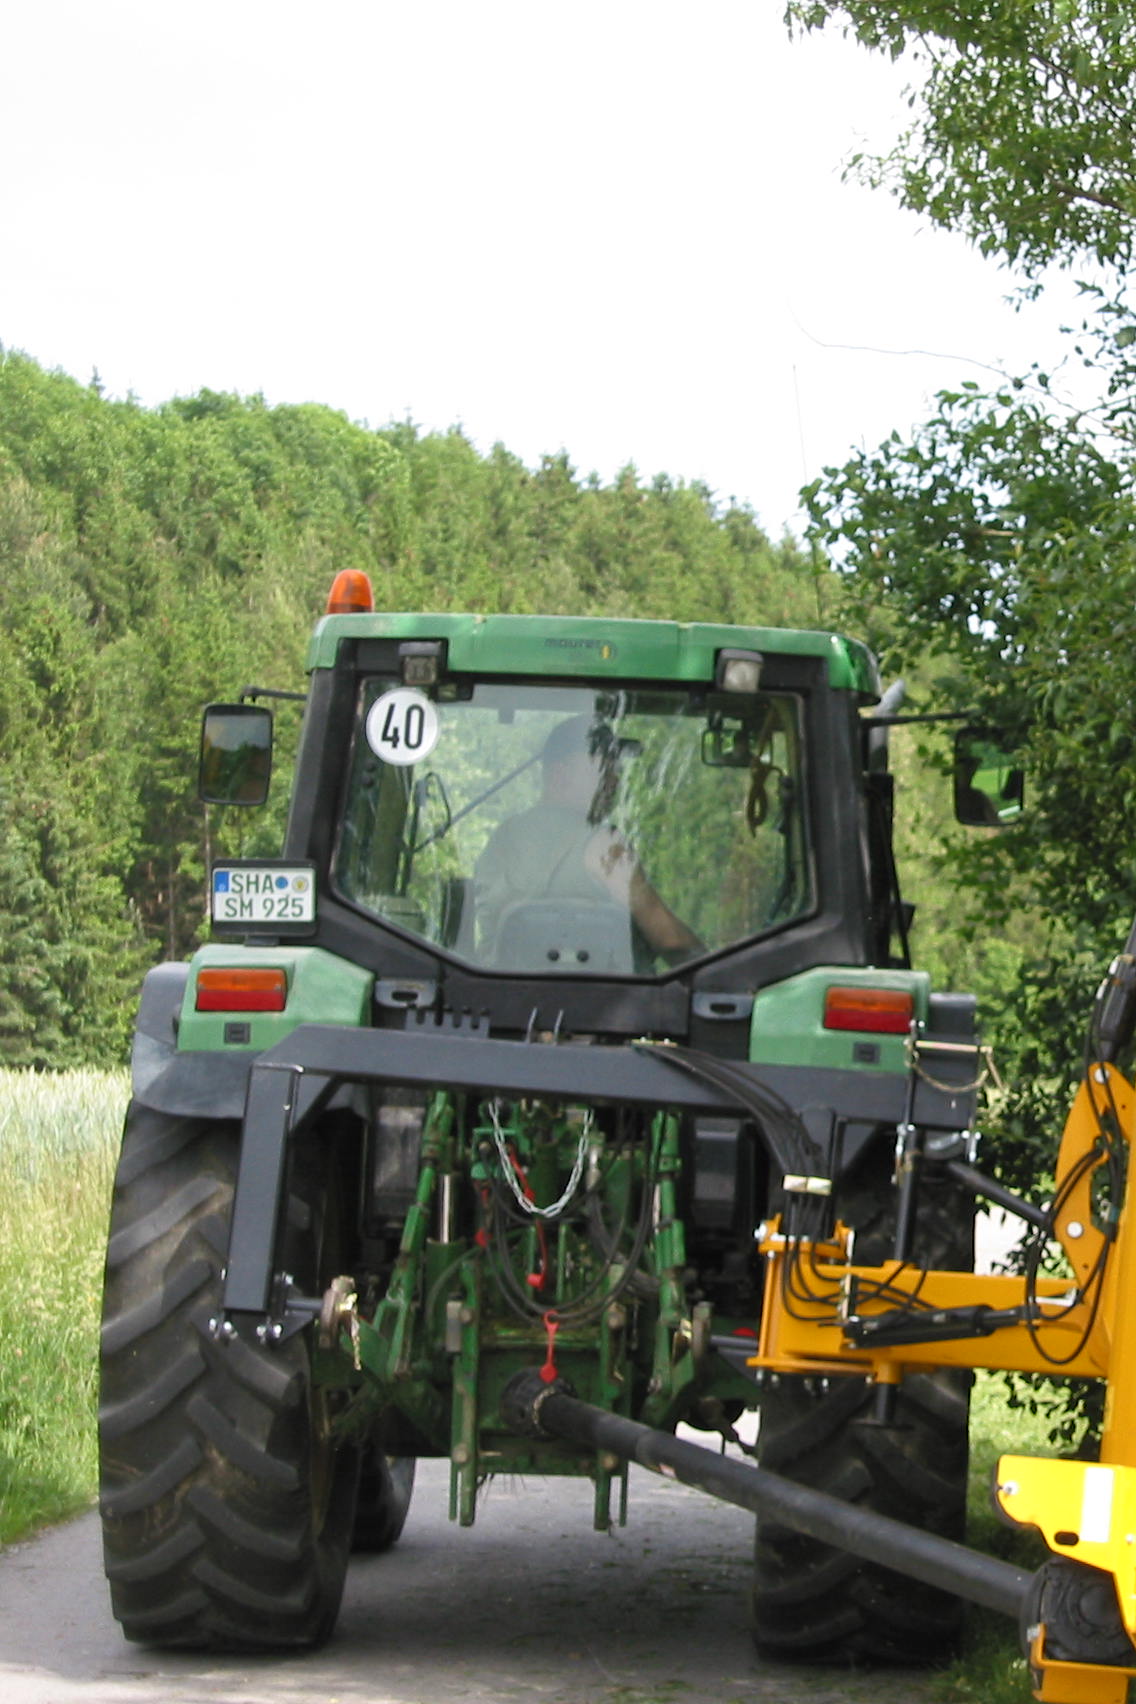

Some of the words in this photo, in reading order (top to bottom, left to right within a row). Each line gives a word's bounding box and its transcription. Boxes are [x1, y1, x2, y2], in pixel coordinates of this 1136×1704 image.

[381, 703, 425, 750] 40
[231, 873, 274, 894] SHA
[224, 897, 253, 918] SM
[262, 897, 304, 918] 925
